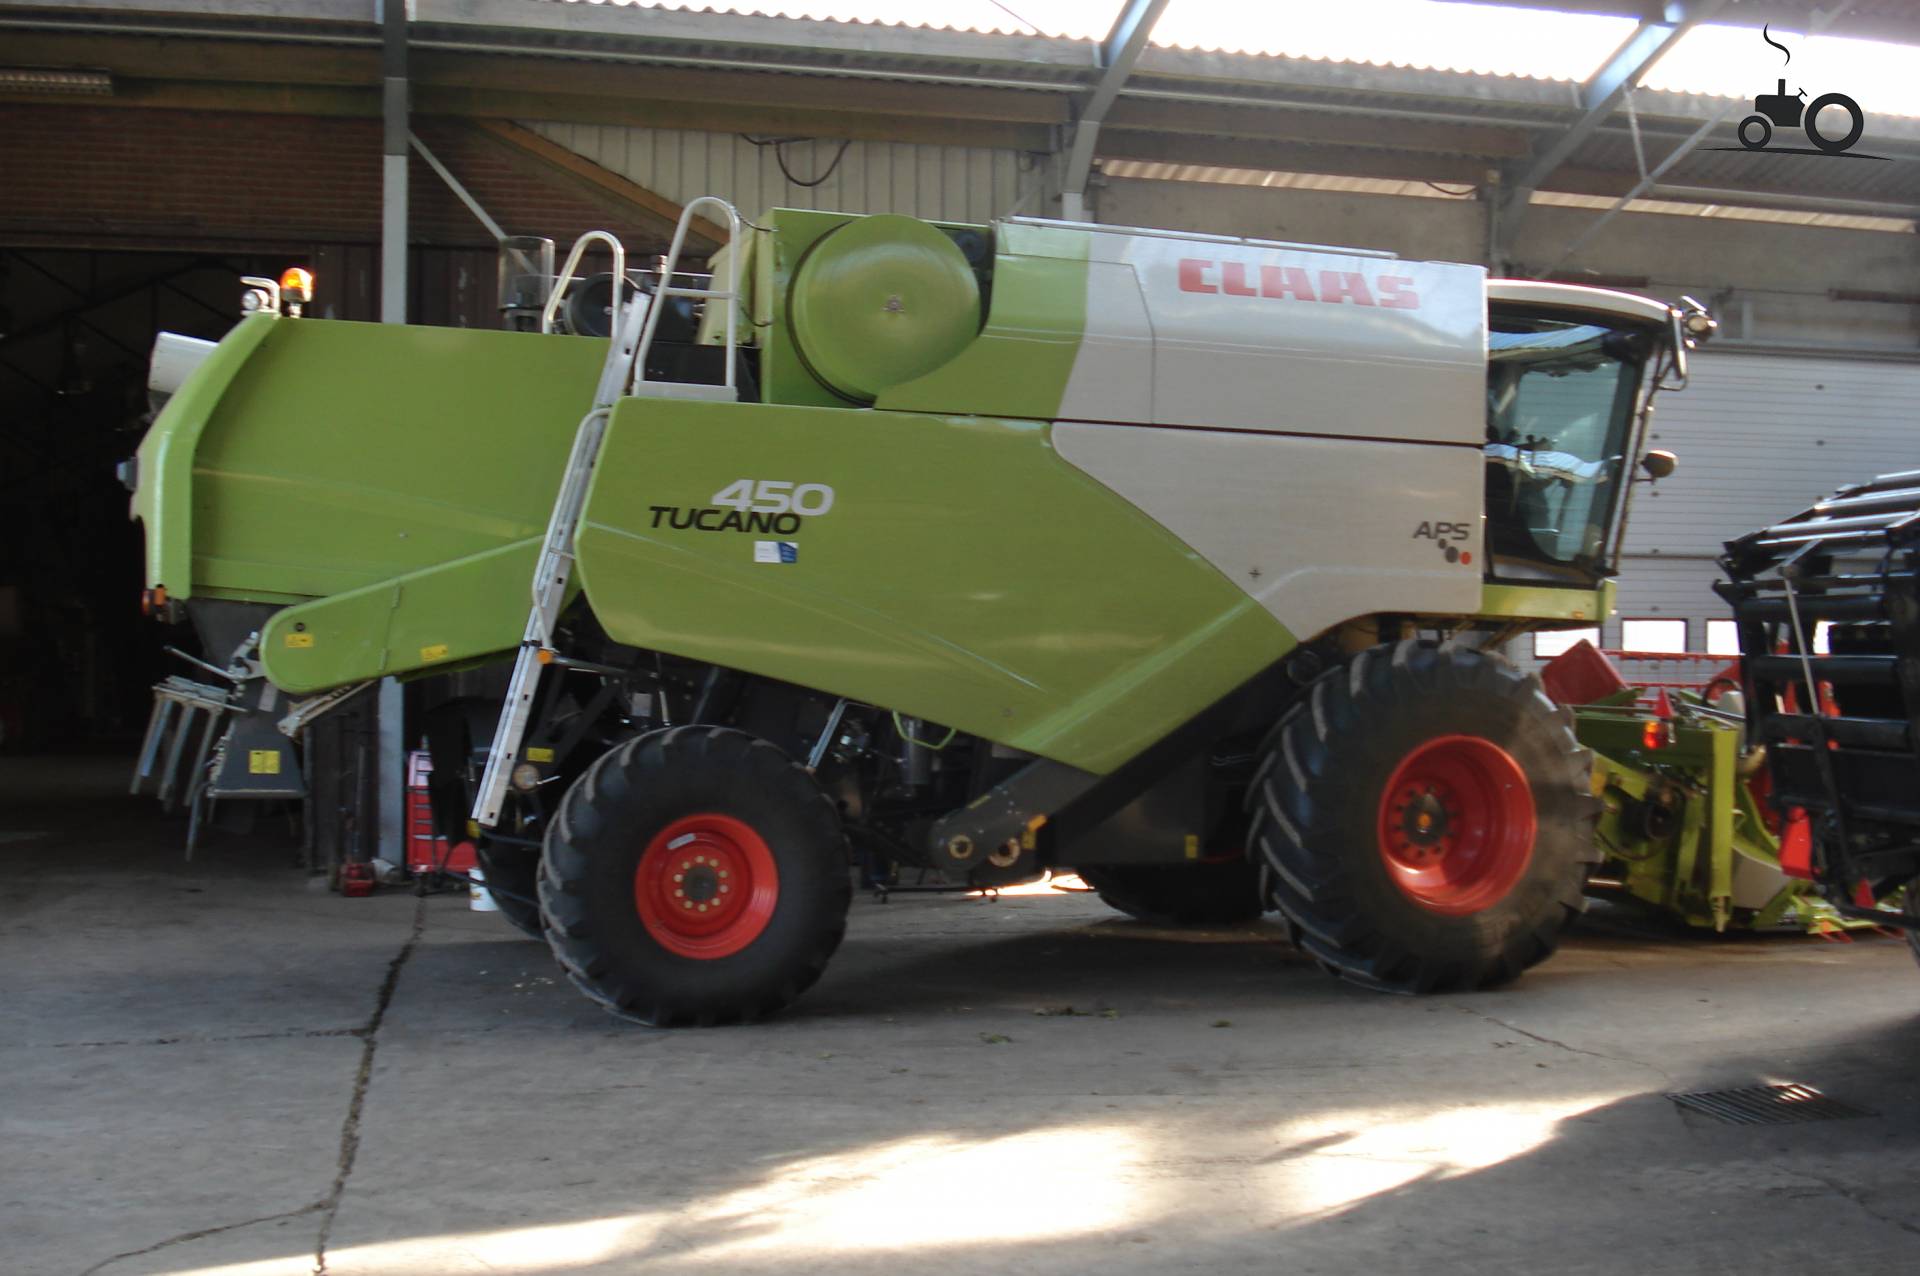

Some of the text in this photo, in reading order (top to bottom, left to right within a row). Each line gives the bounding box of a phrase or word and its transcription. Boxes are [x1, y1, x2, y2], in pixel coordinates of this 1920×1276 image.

[1178, 258, 1419, 309] CLAAS
[711, 479, 835, 516] 450
[649, 506, 801, 535] TUCANO
[1412, 521, 1470, 540] APS
